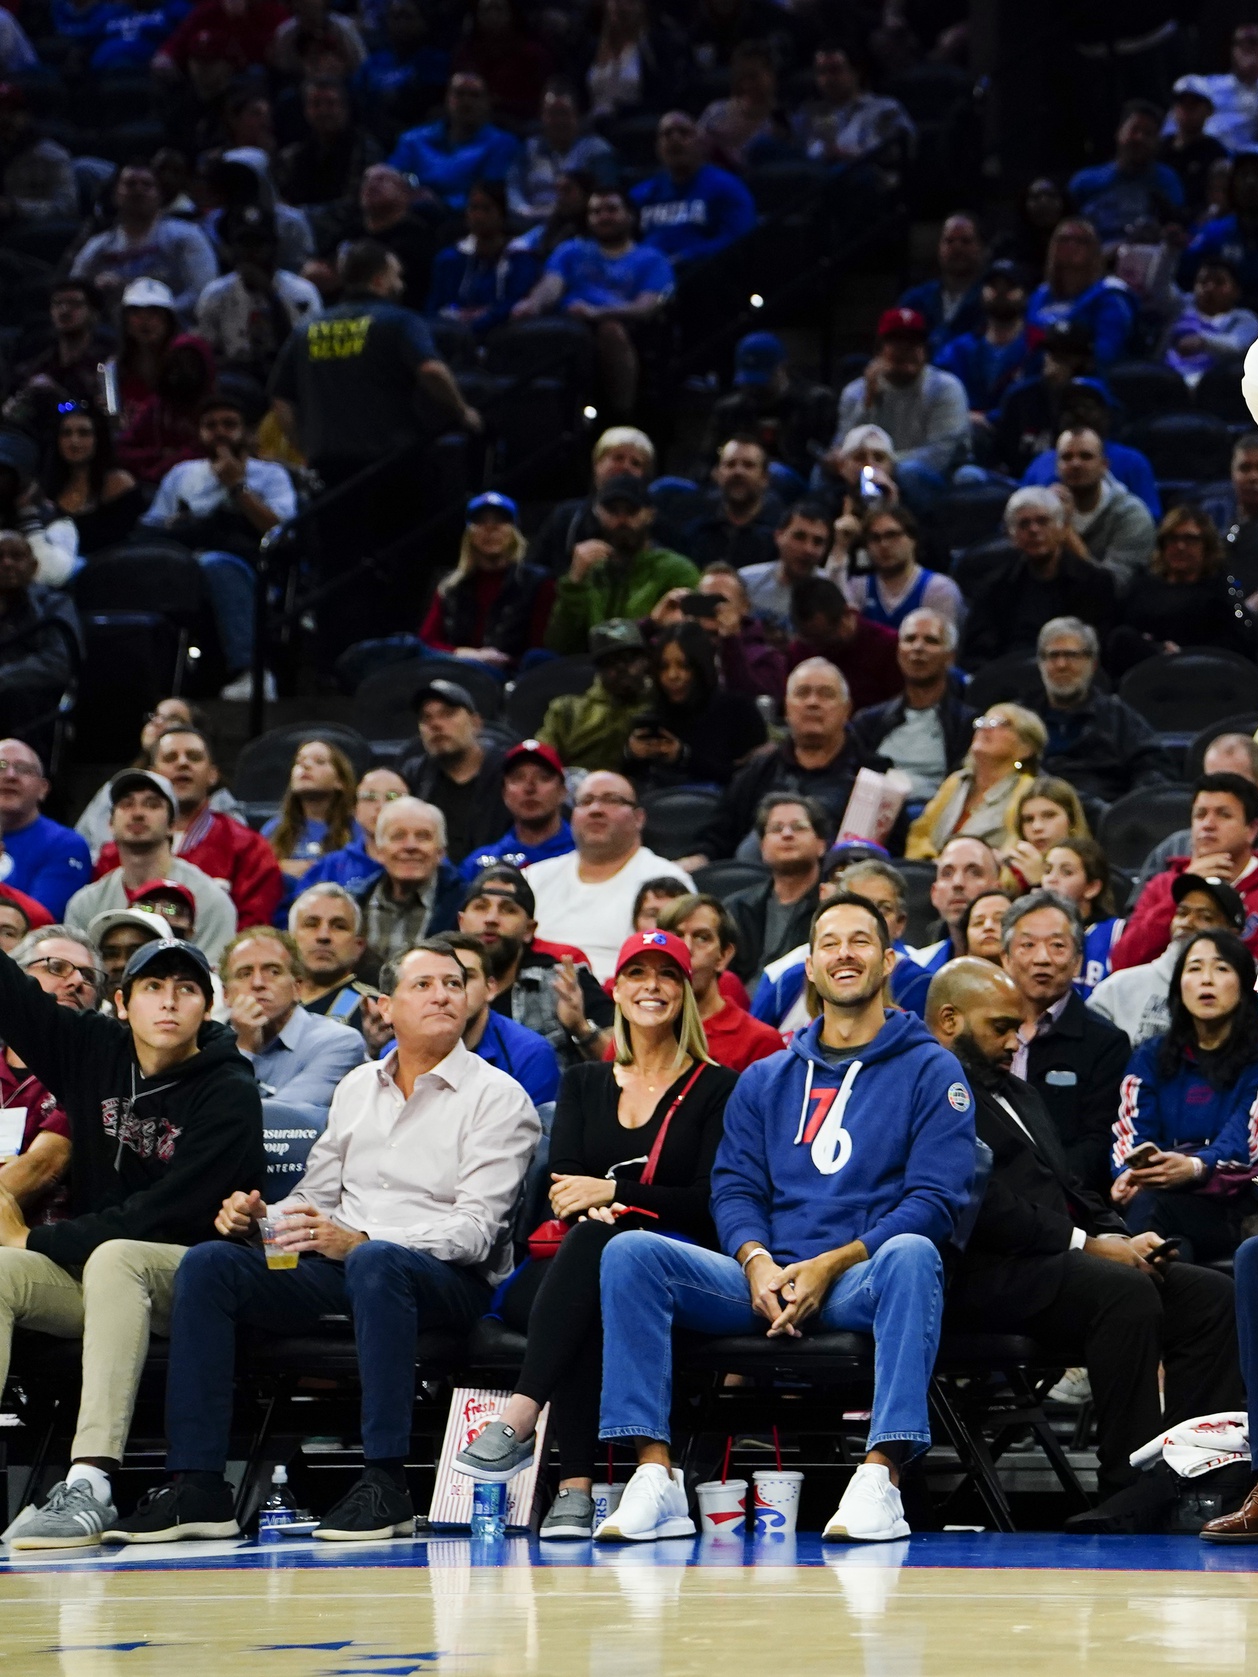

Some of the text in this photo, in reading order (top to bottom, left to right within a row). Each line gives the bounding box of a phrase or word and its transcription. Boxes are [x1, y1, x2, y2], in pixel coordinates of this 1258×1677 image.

[643, 931, 666, 945] 76
[802, 1088, 853, 1175] 76
[463, 1397, 496, 1422] fresh
